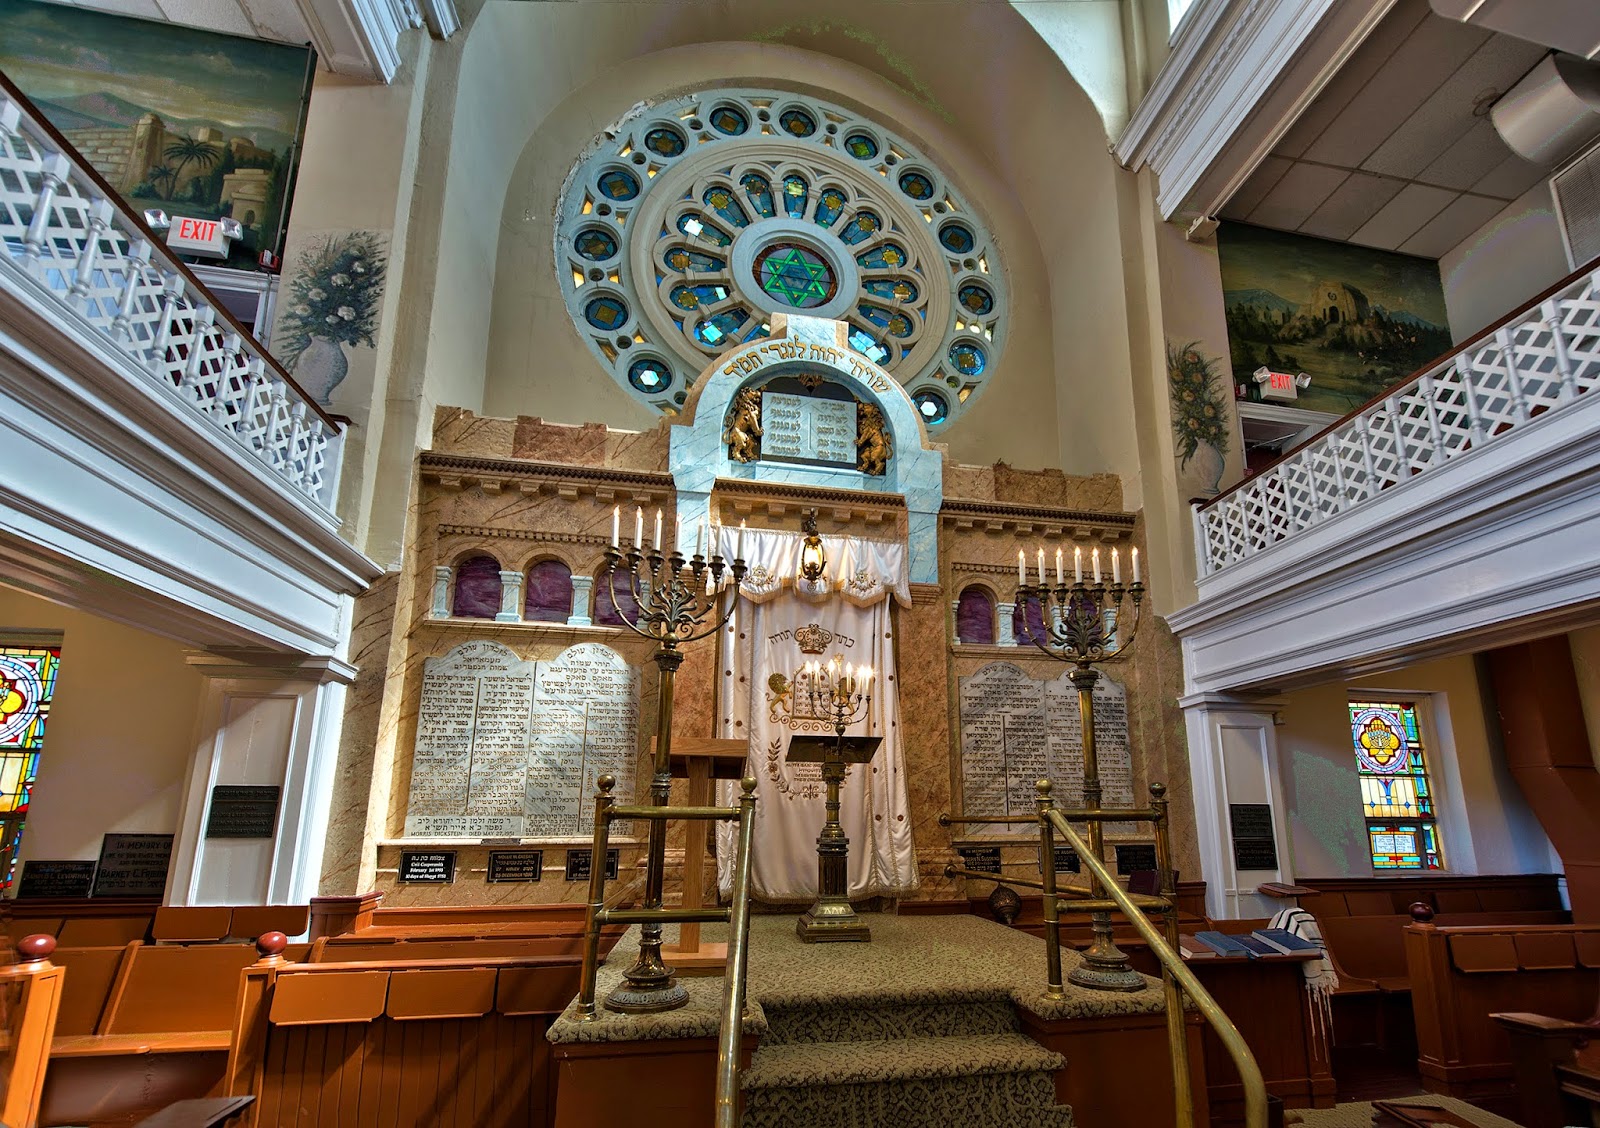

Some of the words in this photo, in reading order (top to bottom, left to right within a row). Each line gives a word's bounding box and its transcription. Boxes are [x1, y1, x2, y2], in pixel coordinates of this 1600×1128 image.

[180, 220, 216, 241] EXIT
[810, 344, 845, 364] יהוה
[723, 351, 763, 378] תמיד
[1270, 374, 1291, 390] EXIT
[768, 630, 793, 644] תורה
[835, 633, 854, 648] כתר
